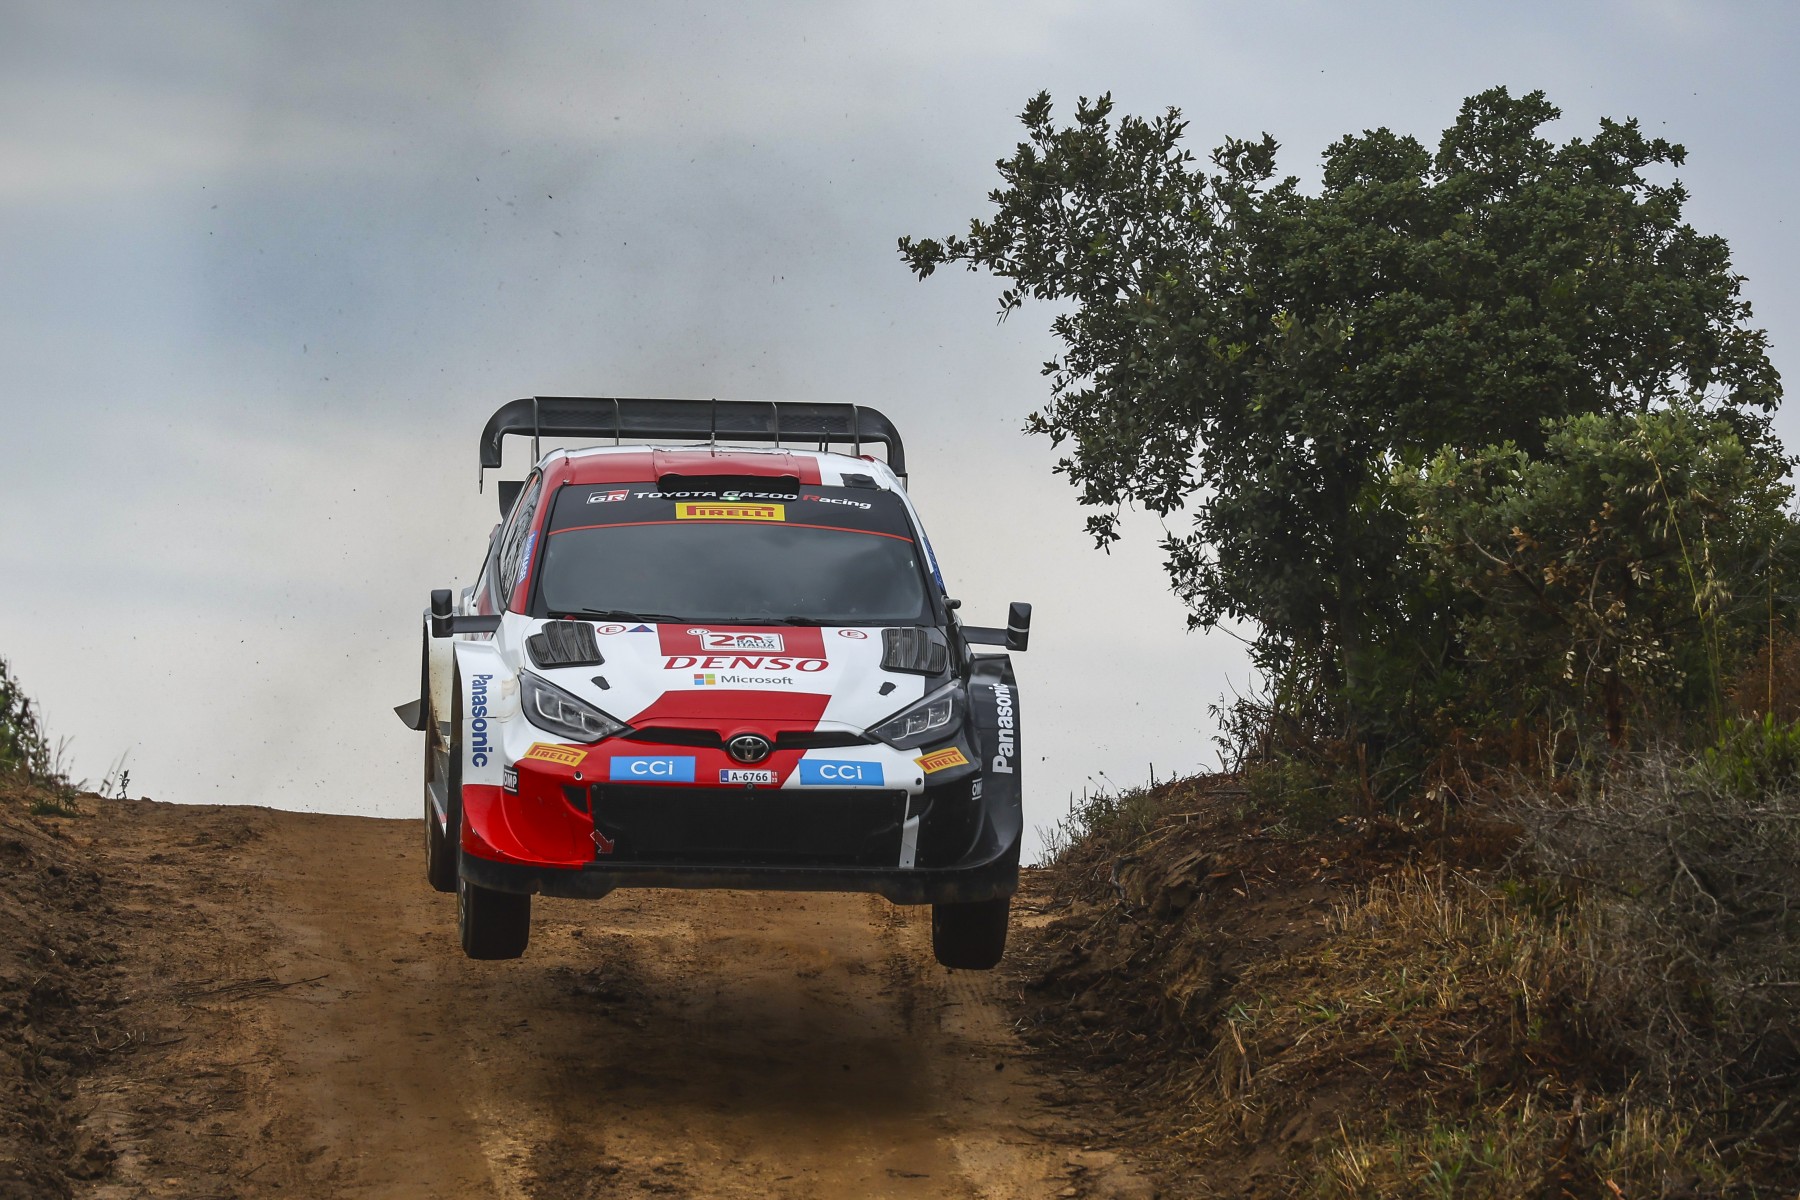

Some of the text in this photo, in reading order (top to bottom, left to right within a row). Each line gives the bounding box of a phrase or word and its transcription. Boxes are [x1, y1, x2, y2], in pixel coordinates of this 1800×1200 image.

[588, 493, 625, 503] GR
[633, 491, 717, 499] TOYOTA
[802, 494, 872, 510] Racing
[686, 505, 775, 518] PIRELLI
[663, 656, 829, 673] DENSO
[721, 675, 794, 685] Microsoft
[471, 674, 493, 768] Panasonic
[988, 683, 1014, 774] Panasonic
[529, 744, 581, 763] PIRELLI
[919, 750, 964, 771] PIRELLI
[731, 771, 768, 782] A-6766
